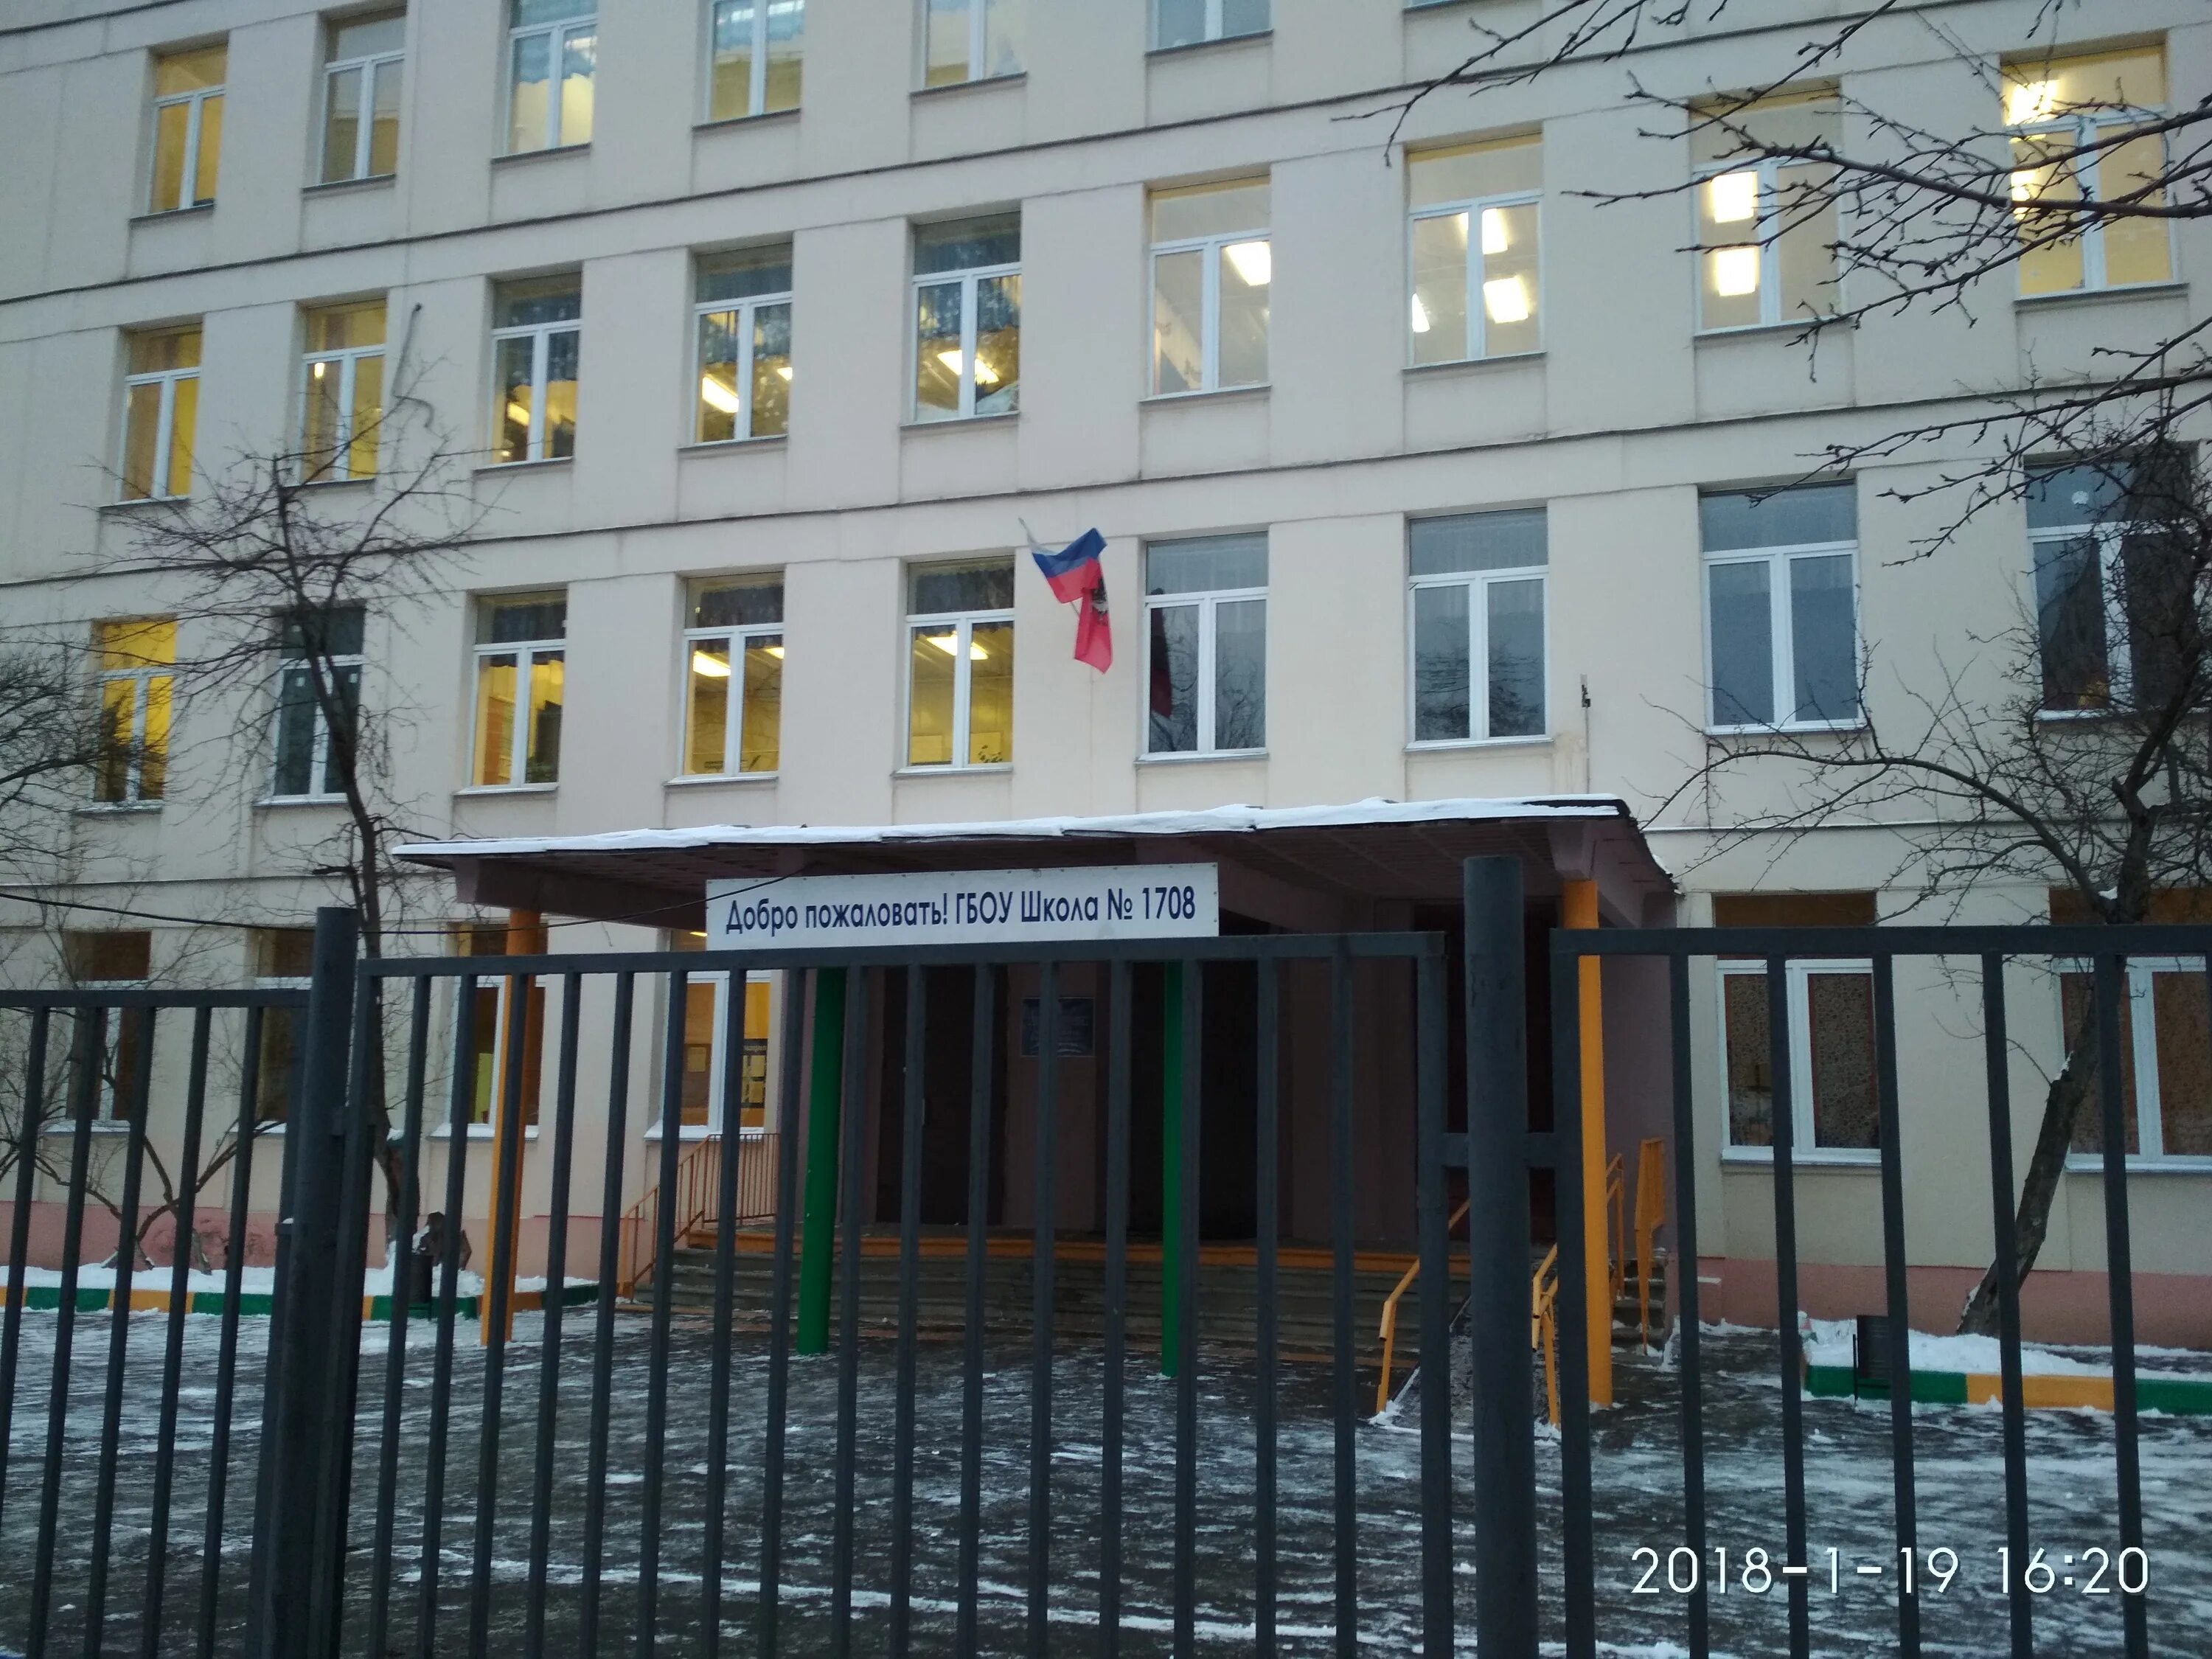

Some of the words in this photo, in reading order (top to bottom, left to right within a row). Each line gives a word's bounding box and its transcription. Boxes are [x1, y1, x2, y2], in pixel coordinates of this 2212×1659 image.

[726, 898, 799, 936] Добро
[805, 891, 948, 929] пожаловать!
[956, 891, 1012, 925] ГБОУ
[1020, 889, 1099, 923] Школа
[1107, 888, 1133, 920] №
[1141, 885, 1196, 920] 1708
